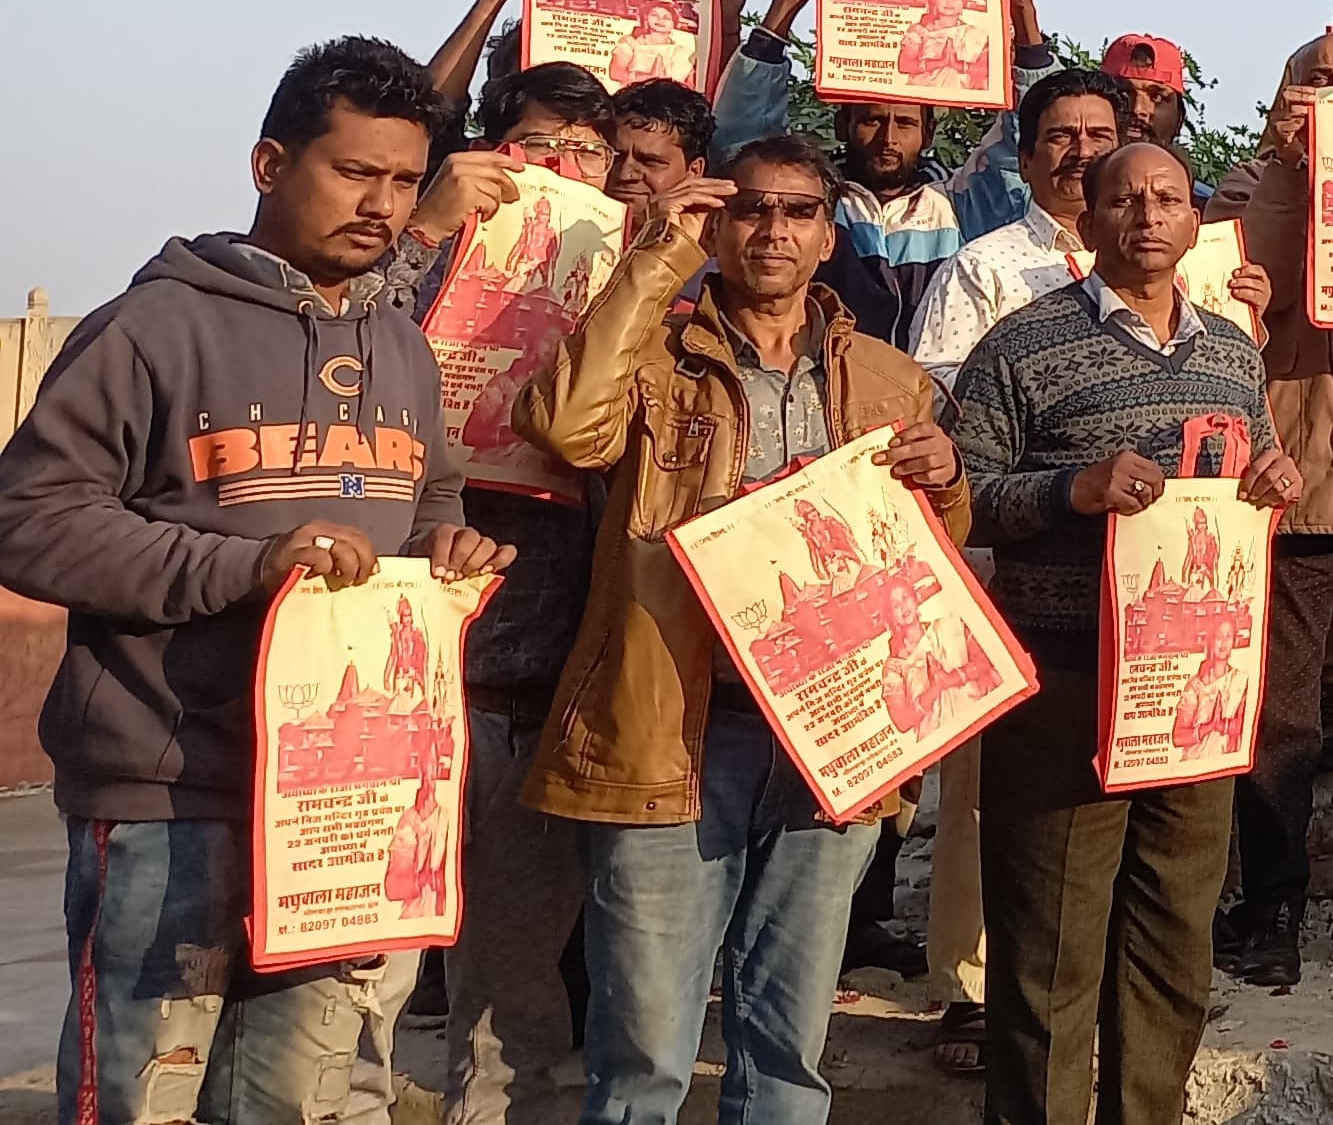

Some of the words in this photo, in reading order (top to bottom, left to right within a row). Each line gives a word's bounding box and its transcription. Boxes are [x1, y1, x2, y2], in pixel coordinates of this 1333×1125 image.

[188, 422, 426, 483] BEARS
[297, 794, 353, 813] रामचन्द्र
[357, 789, 377, 805] जी
[292, 859, 323, 872] सादर
[327, 850, 374, 868] आमंत्रित
[335, 883, 381, 900] महाजन
[301, 919, 336, 932] 82097
[342, 913, 378, 927] 04883
